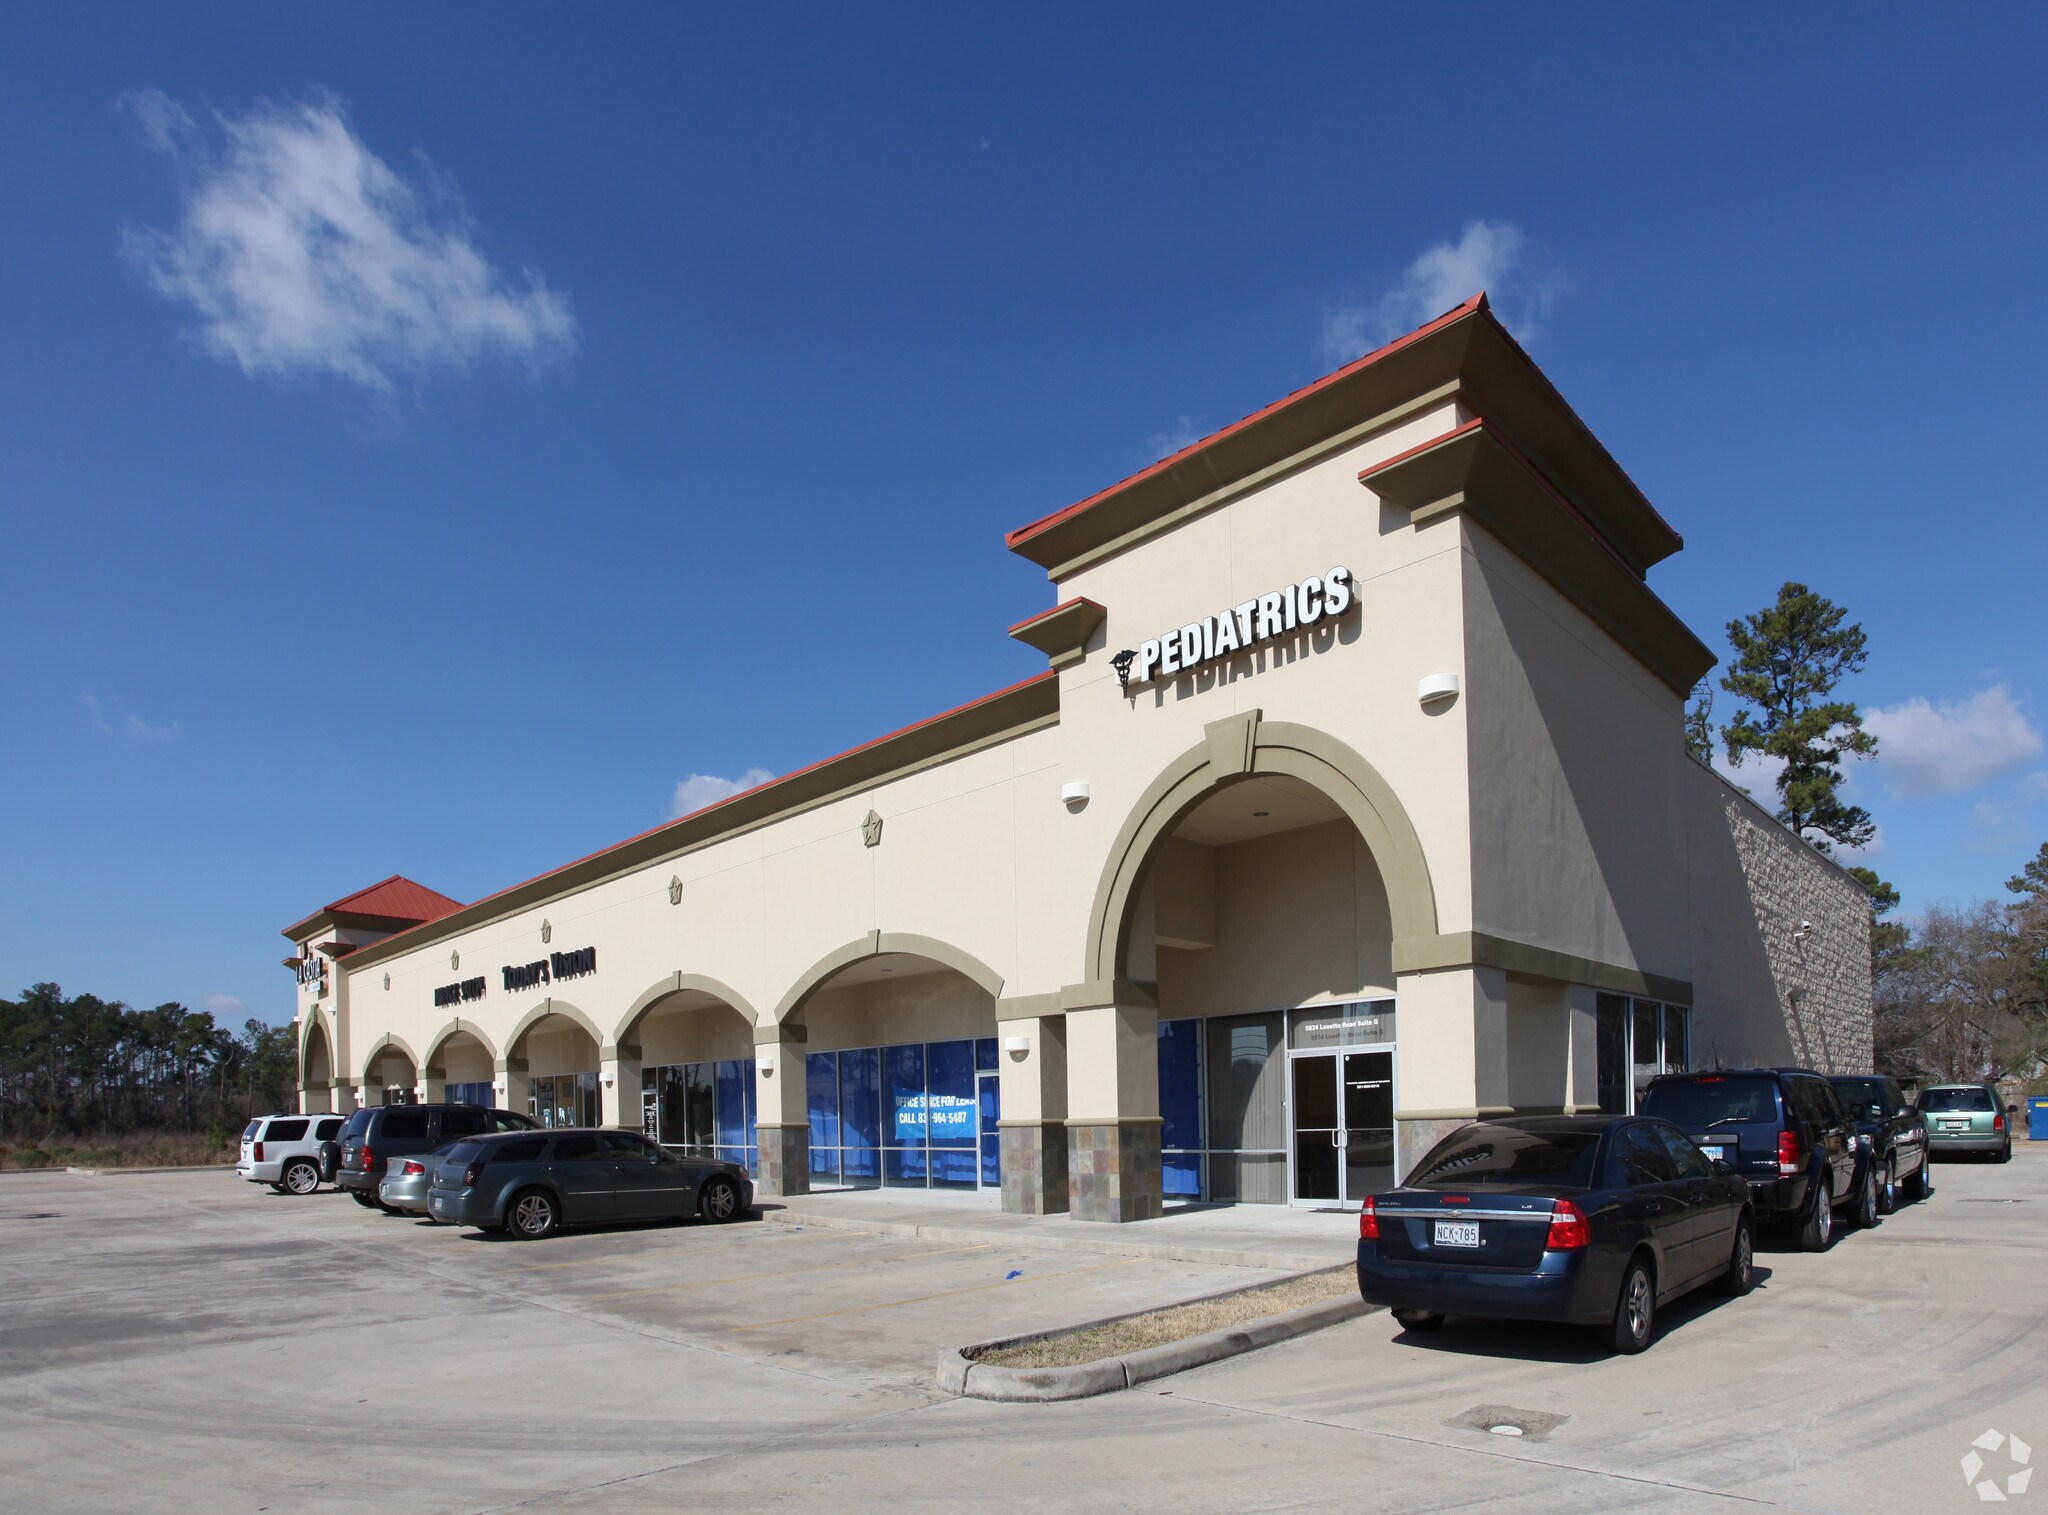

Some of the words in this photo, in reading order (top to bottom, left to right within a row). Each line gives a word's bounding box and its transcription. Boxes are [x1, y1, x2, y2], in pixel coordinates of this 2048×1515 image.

[1140, 565, 1351, 682] PEDIATRICS
[550, 946, 595, 979] VISION
[896, 1096, 918, 1107] OFFICE
[920, 1096, 940, 1107] SCE
[941, 1096, 956, 1107] FOR
[900, 1112, 916, 1124] CALL
[918, 1112, 966, 1124] 83-964-5487
